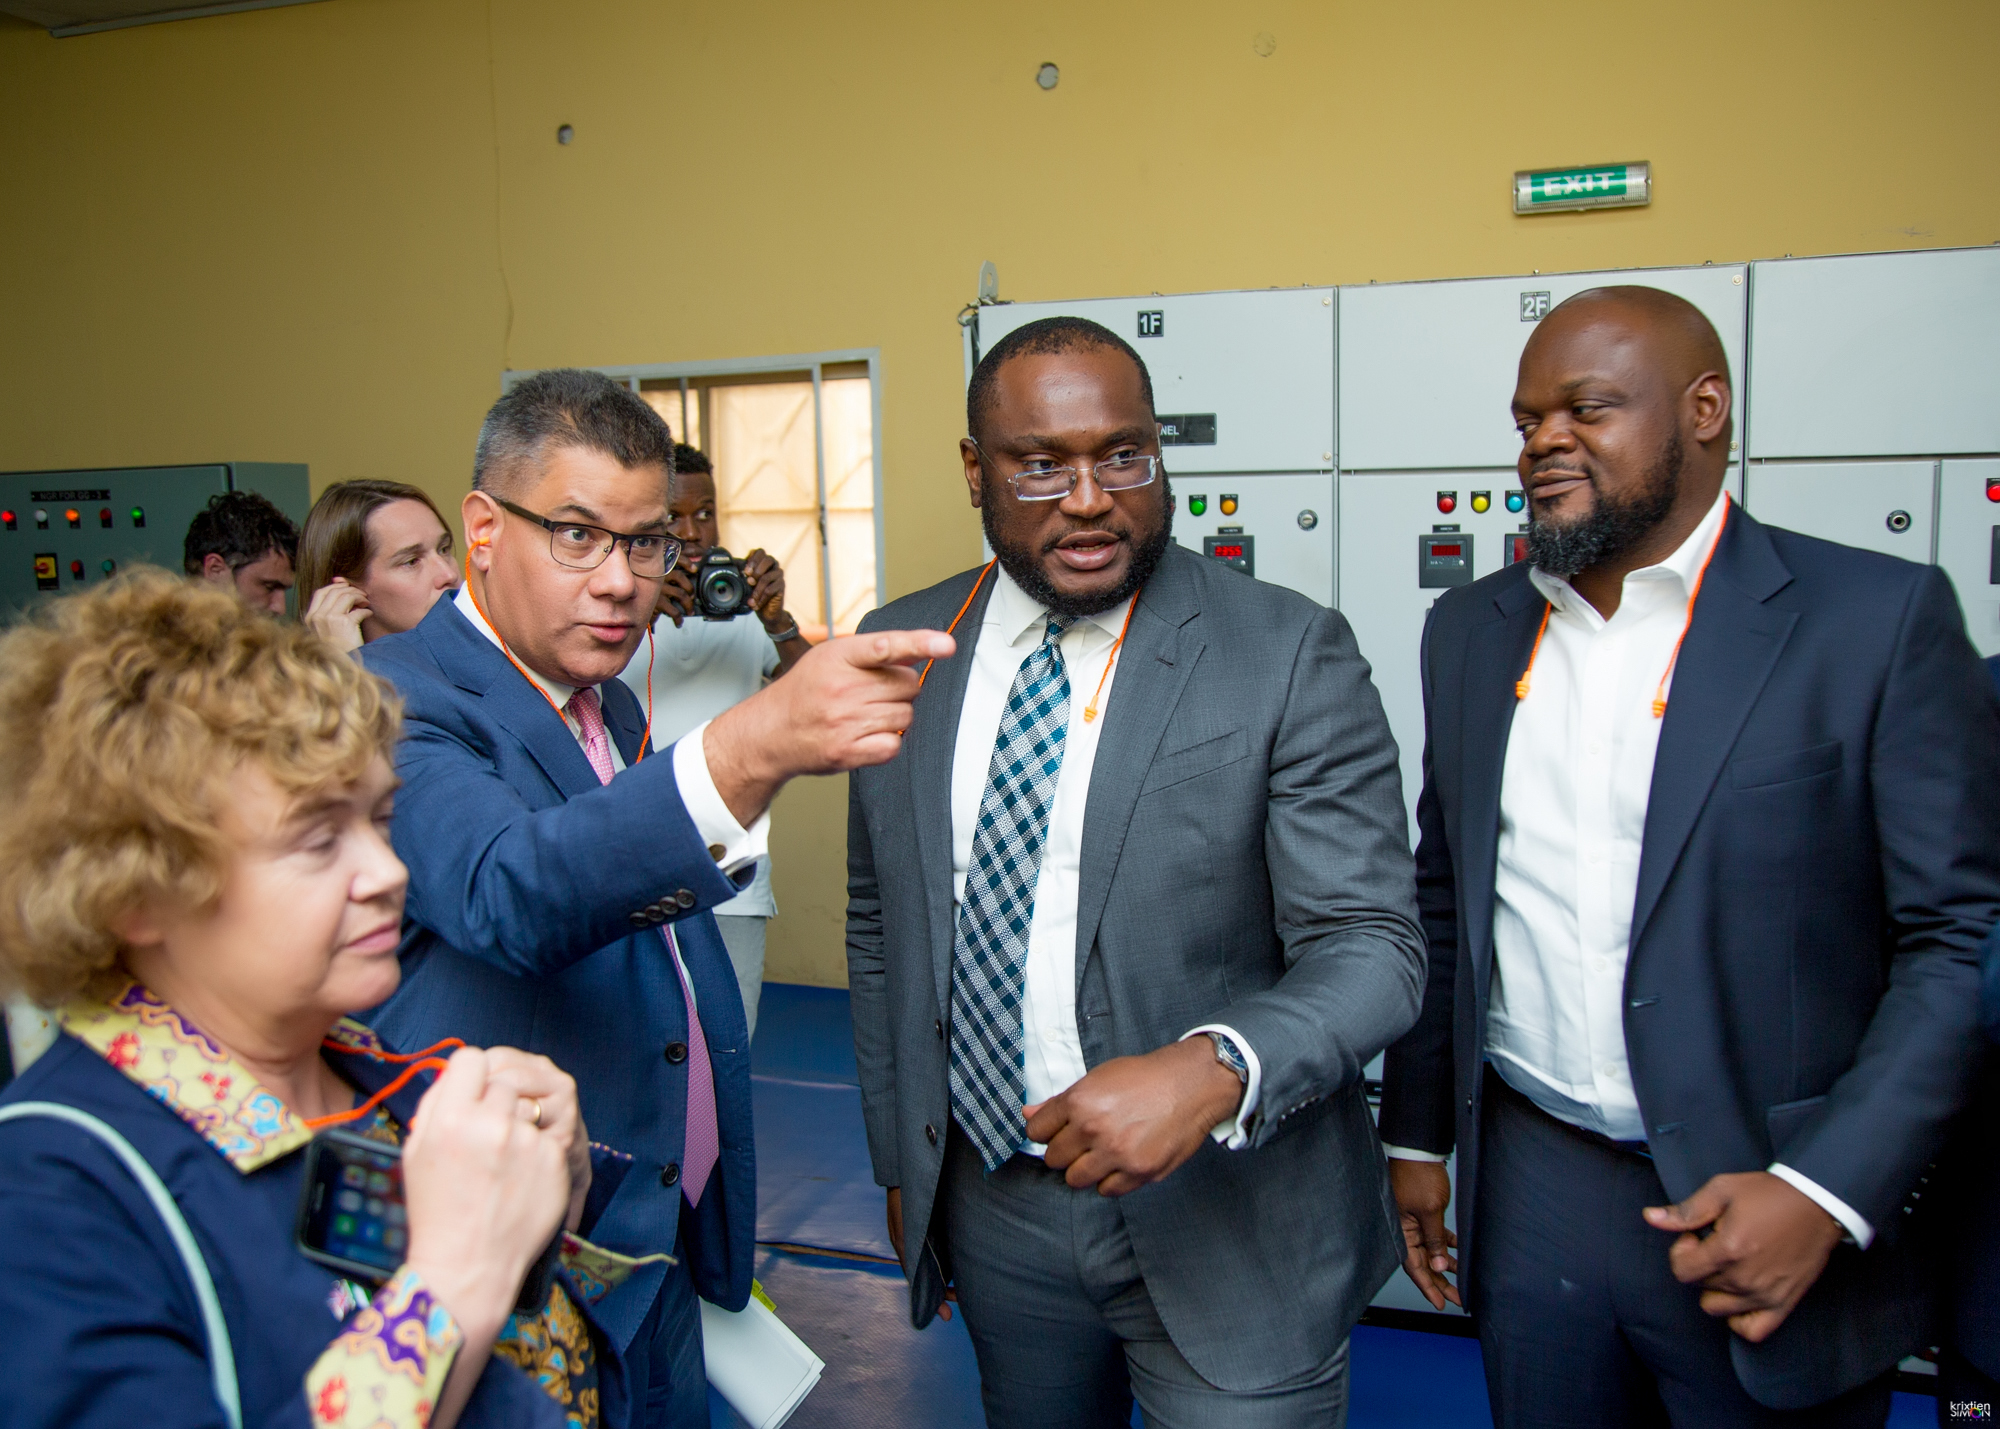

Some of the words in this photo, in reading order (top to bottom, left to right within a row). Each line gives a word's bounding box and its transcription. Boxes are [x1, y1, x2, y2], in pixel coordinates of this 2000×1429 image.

[1544, 172, 1615, 196] EXIT
[1524, 296, 1548, 318] 2F
[1140, 314, 1161, 333] 1F
[1160, 425, 1179, 436] NEL
[59, 492, 76, 500] FOR
